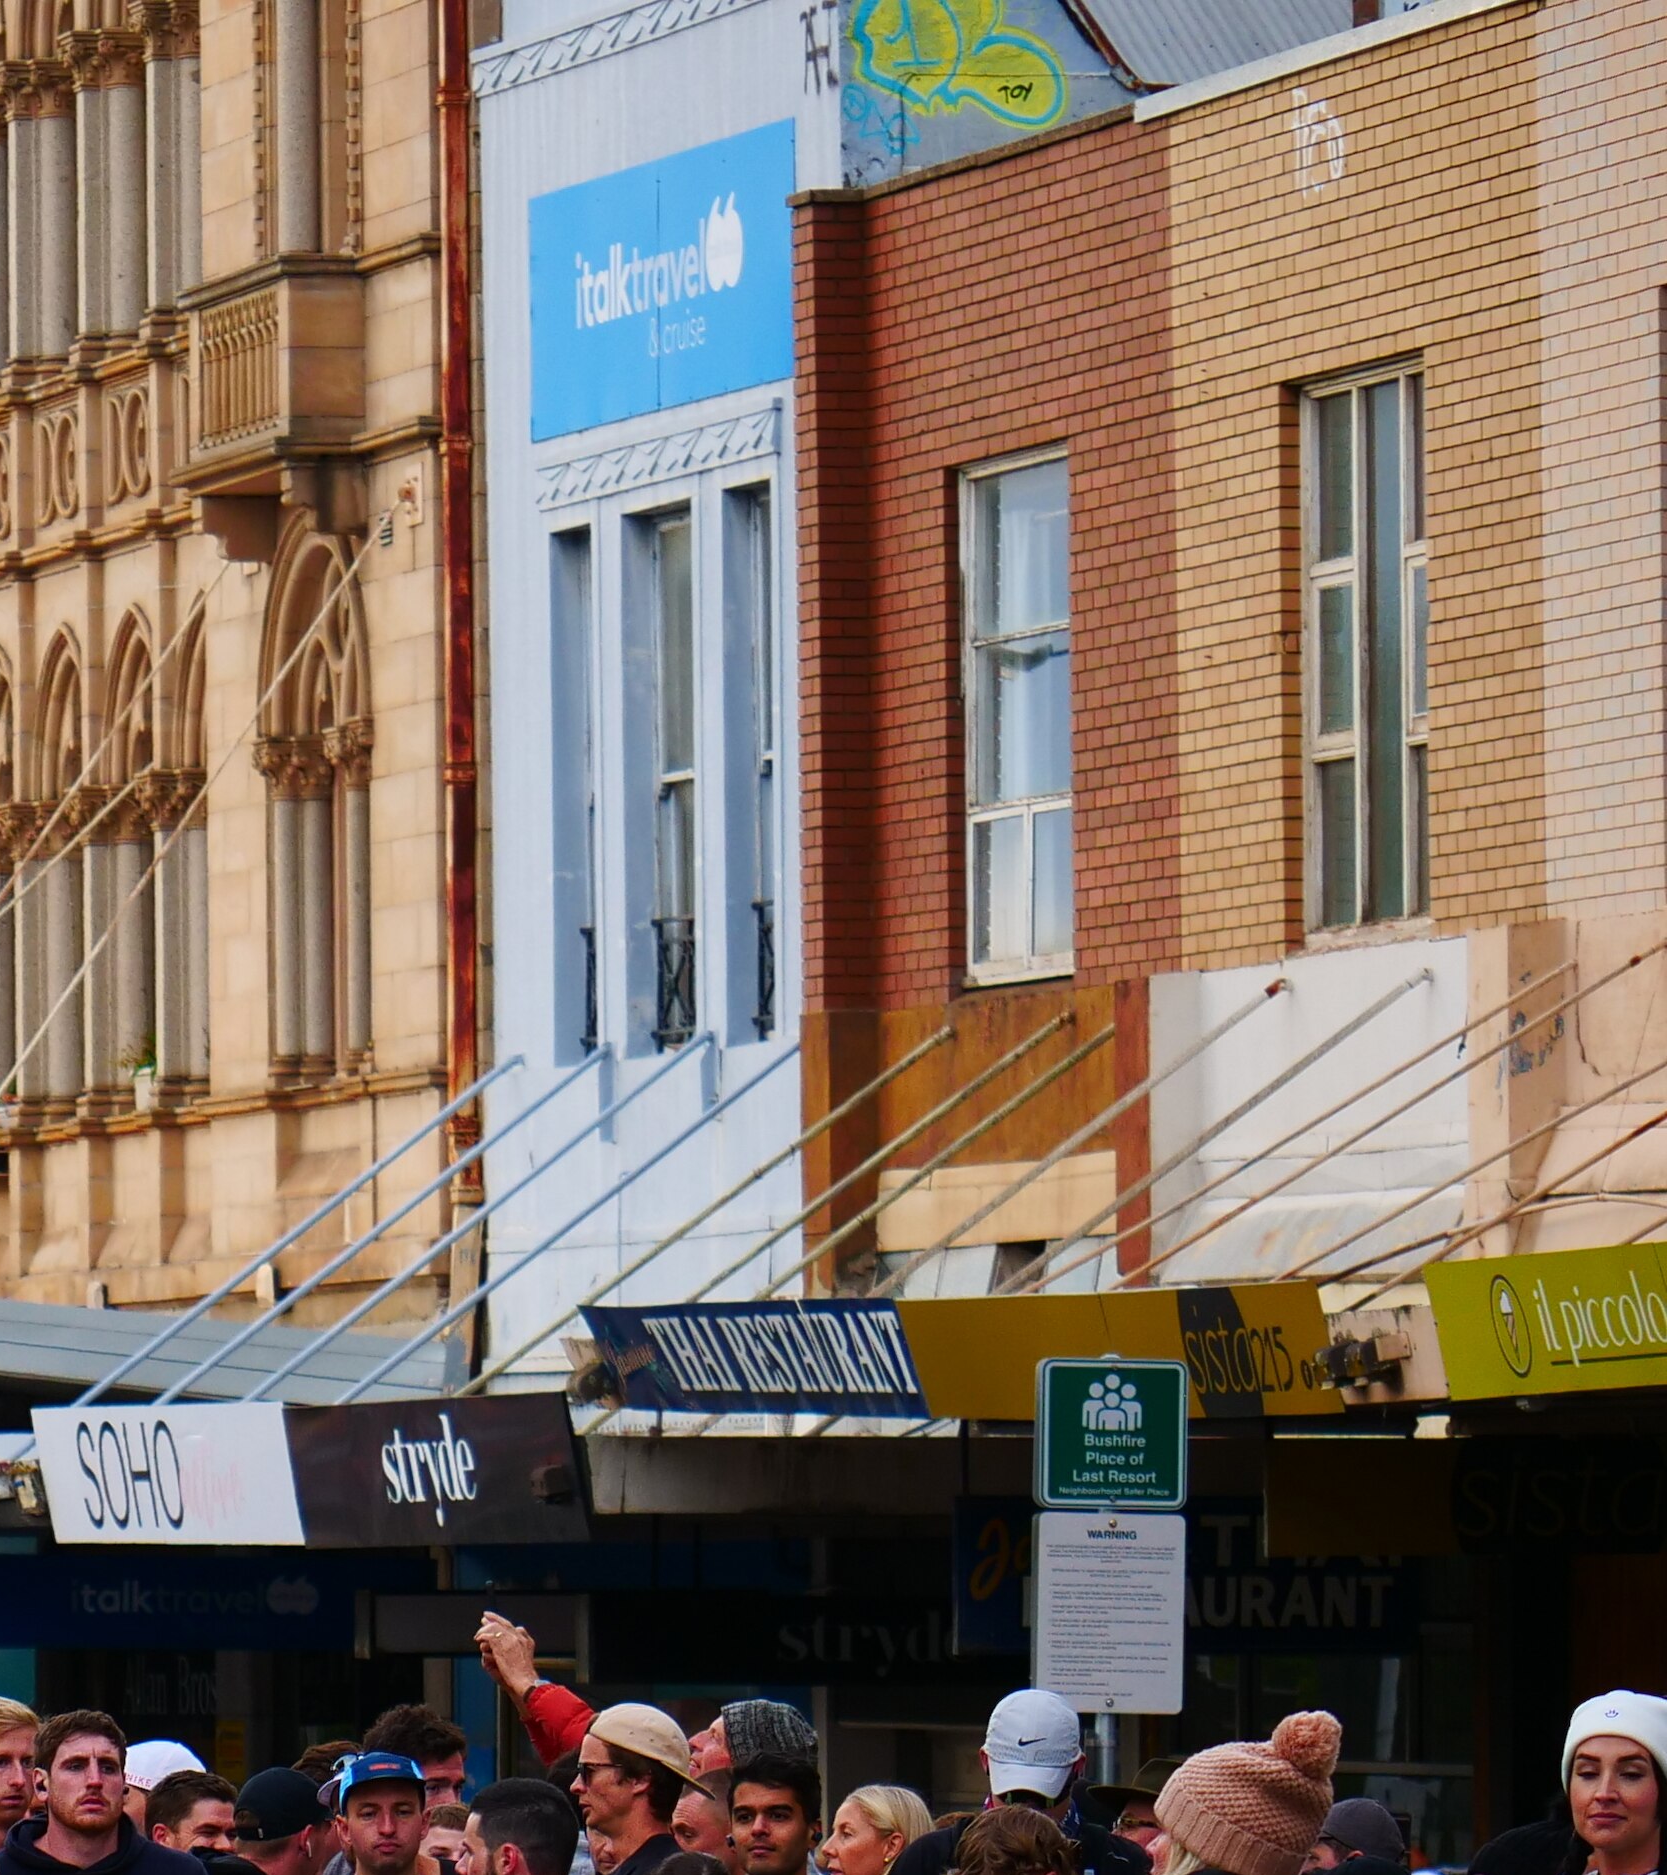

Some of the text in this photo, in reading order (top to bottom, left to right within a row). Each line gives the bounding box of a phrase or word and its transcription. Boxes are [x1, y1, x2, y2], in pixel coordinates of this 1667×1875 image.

[663, 308, 707, 354] cruise
[1533, 1278, 1562, 1351] il
[642, 1311, 919, 1395] THAI RESTAURANT
[1084, 1434, 1147, 1447] Bushfire
[381, 1414, 478, 1527] stryde
[1086, 1452, 1145, 1465] Place of
[76, 1419, 185, 1530] SOHO
[1073, 1469, 1157, 1483] Last Resort
[1059, 1486, 1170, 1497] Neighbourhood Safer Place
[1088, 1529, 1138, 1540] WARNING
